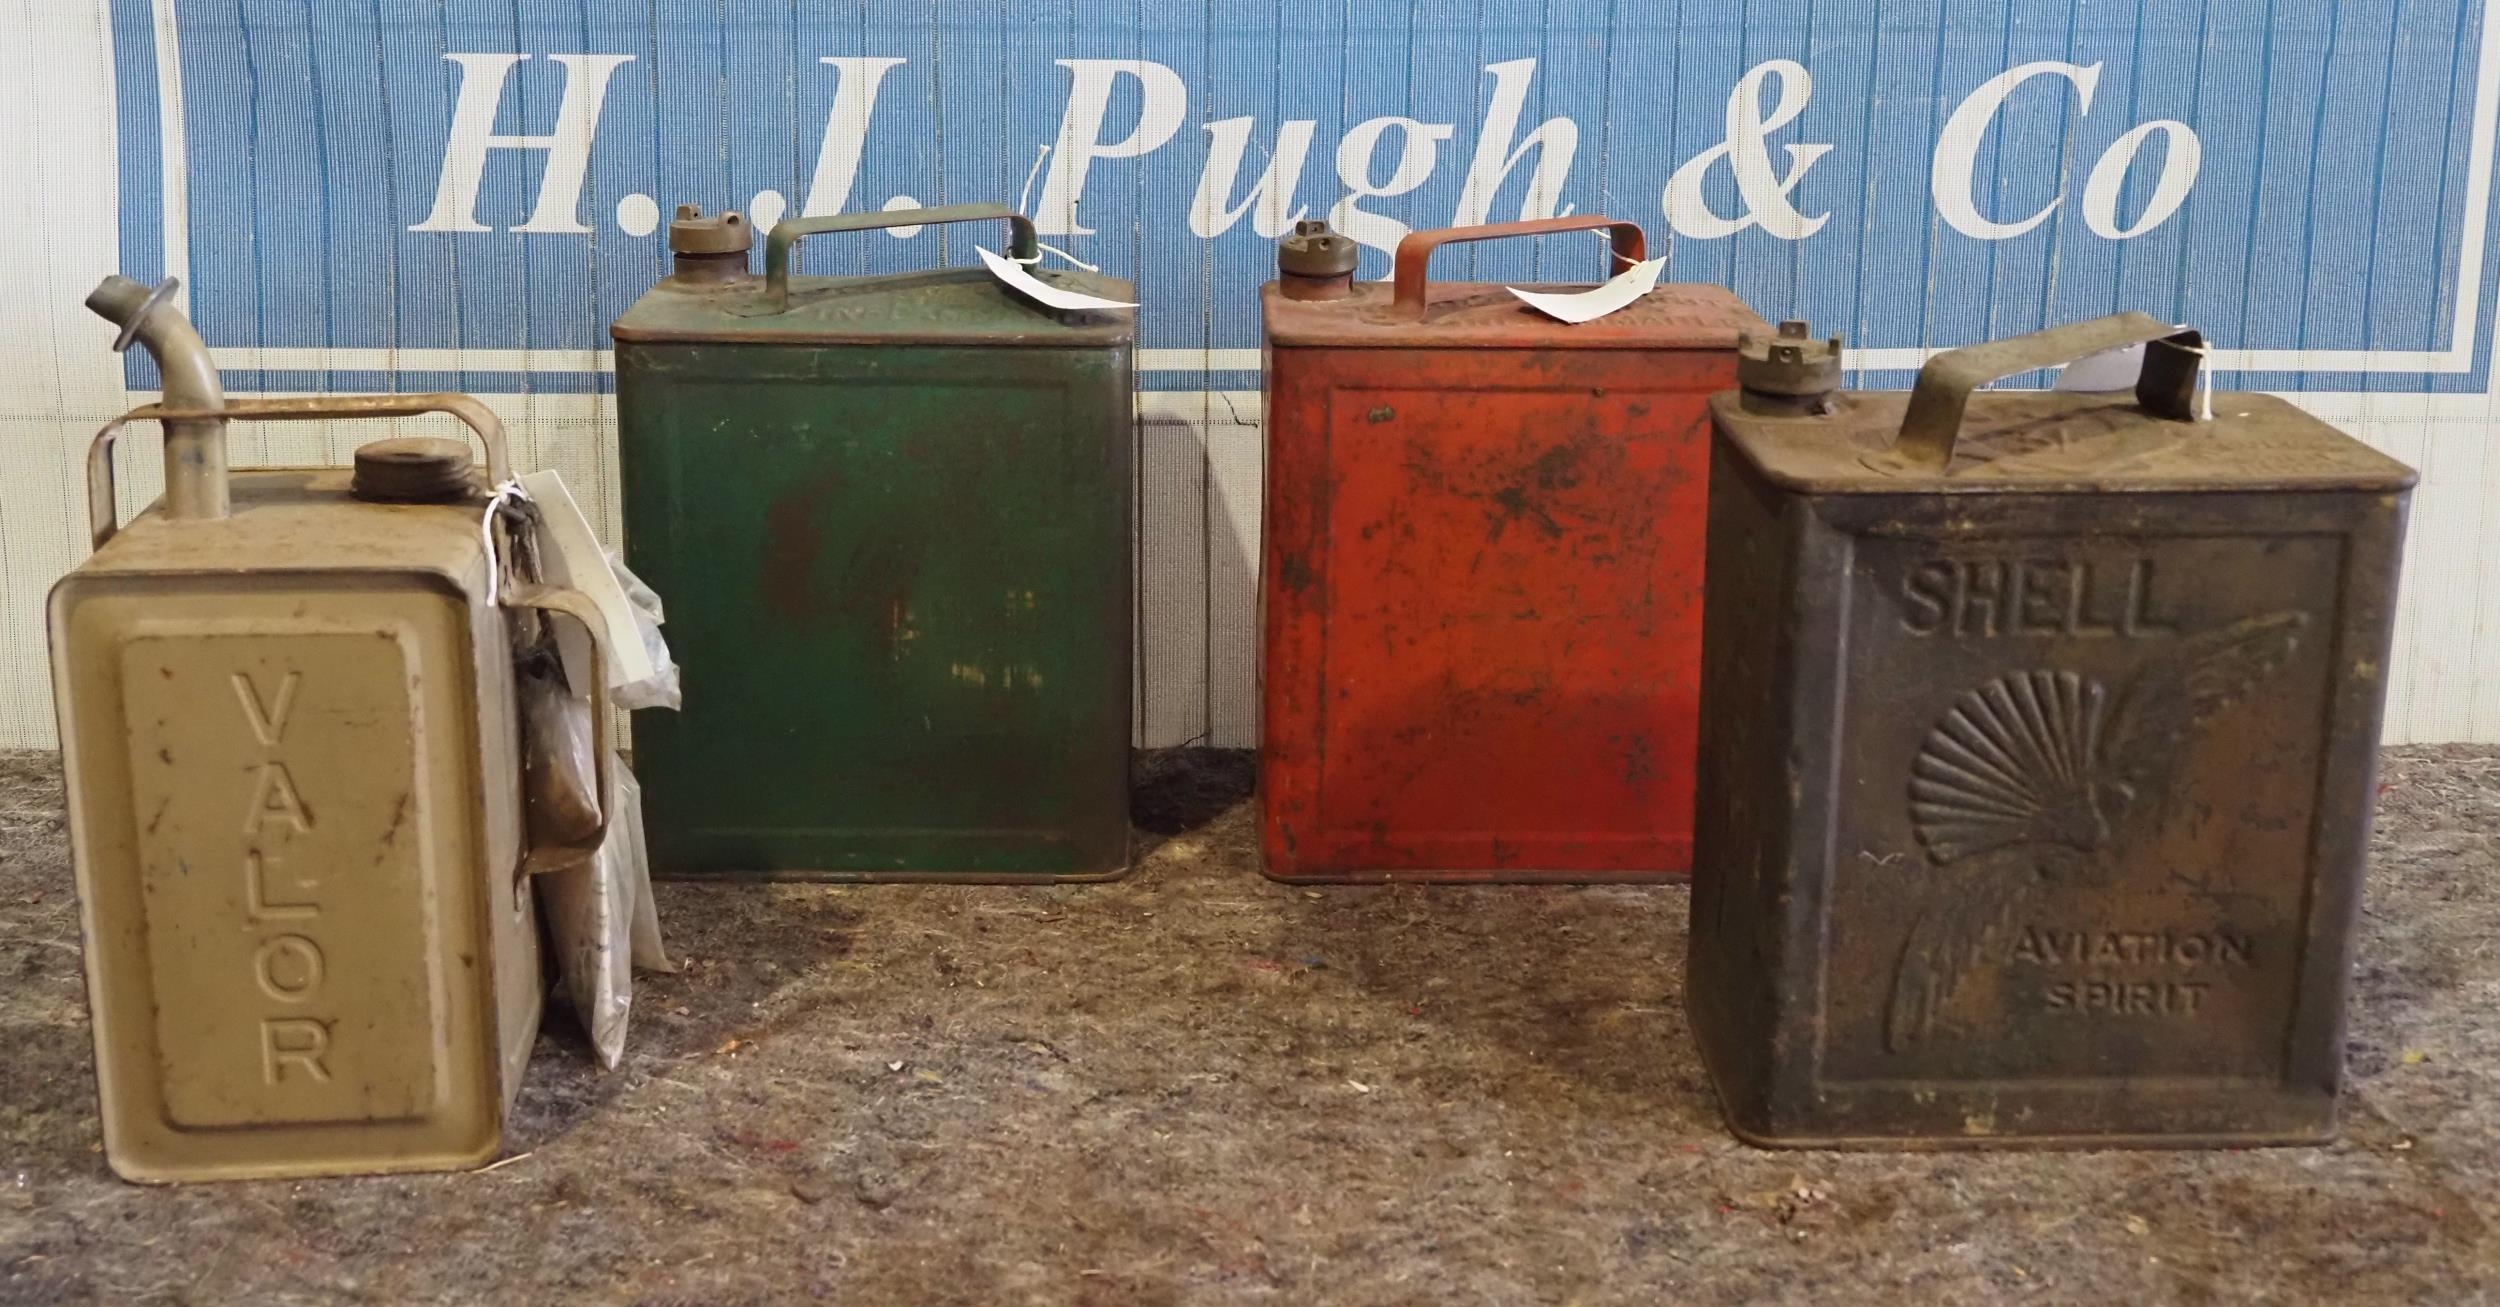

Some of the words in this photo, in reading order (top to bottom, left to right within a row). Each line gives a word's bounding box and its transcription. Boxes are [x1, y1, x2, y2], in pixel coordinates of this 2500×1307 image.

[408, 53, 660, 238] H.
[749, 57, 924, 239] J.
[1026, 57, 1579, 282] Pugh
[1662, 58, 1835, 241] &
[1930, 60, 2202, 240] Co
[1898, 556, 2182, 640] SHELL
[230, 669, 334, 1087] VALOR
[2012, 925, 2253, 968] AVIATION
[2041, 981, 2211, 1017] SPIRIT
